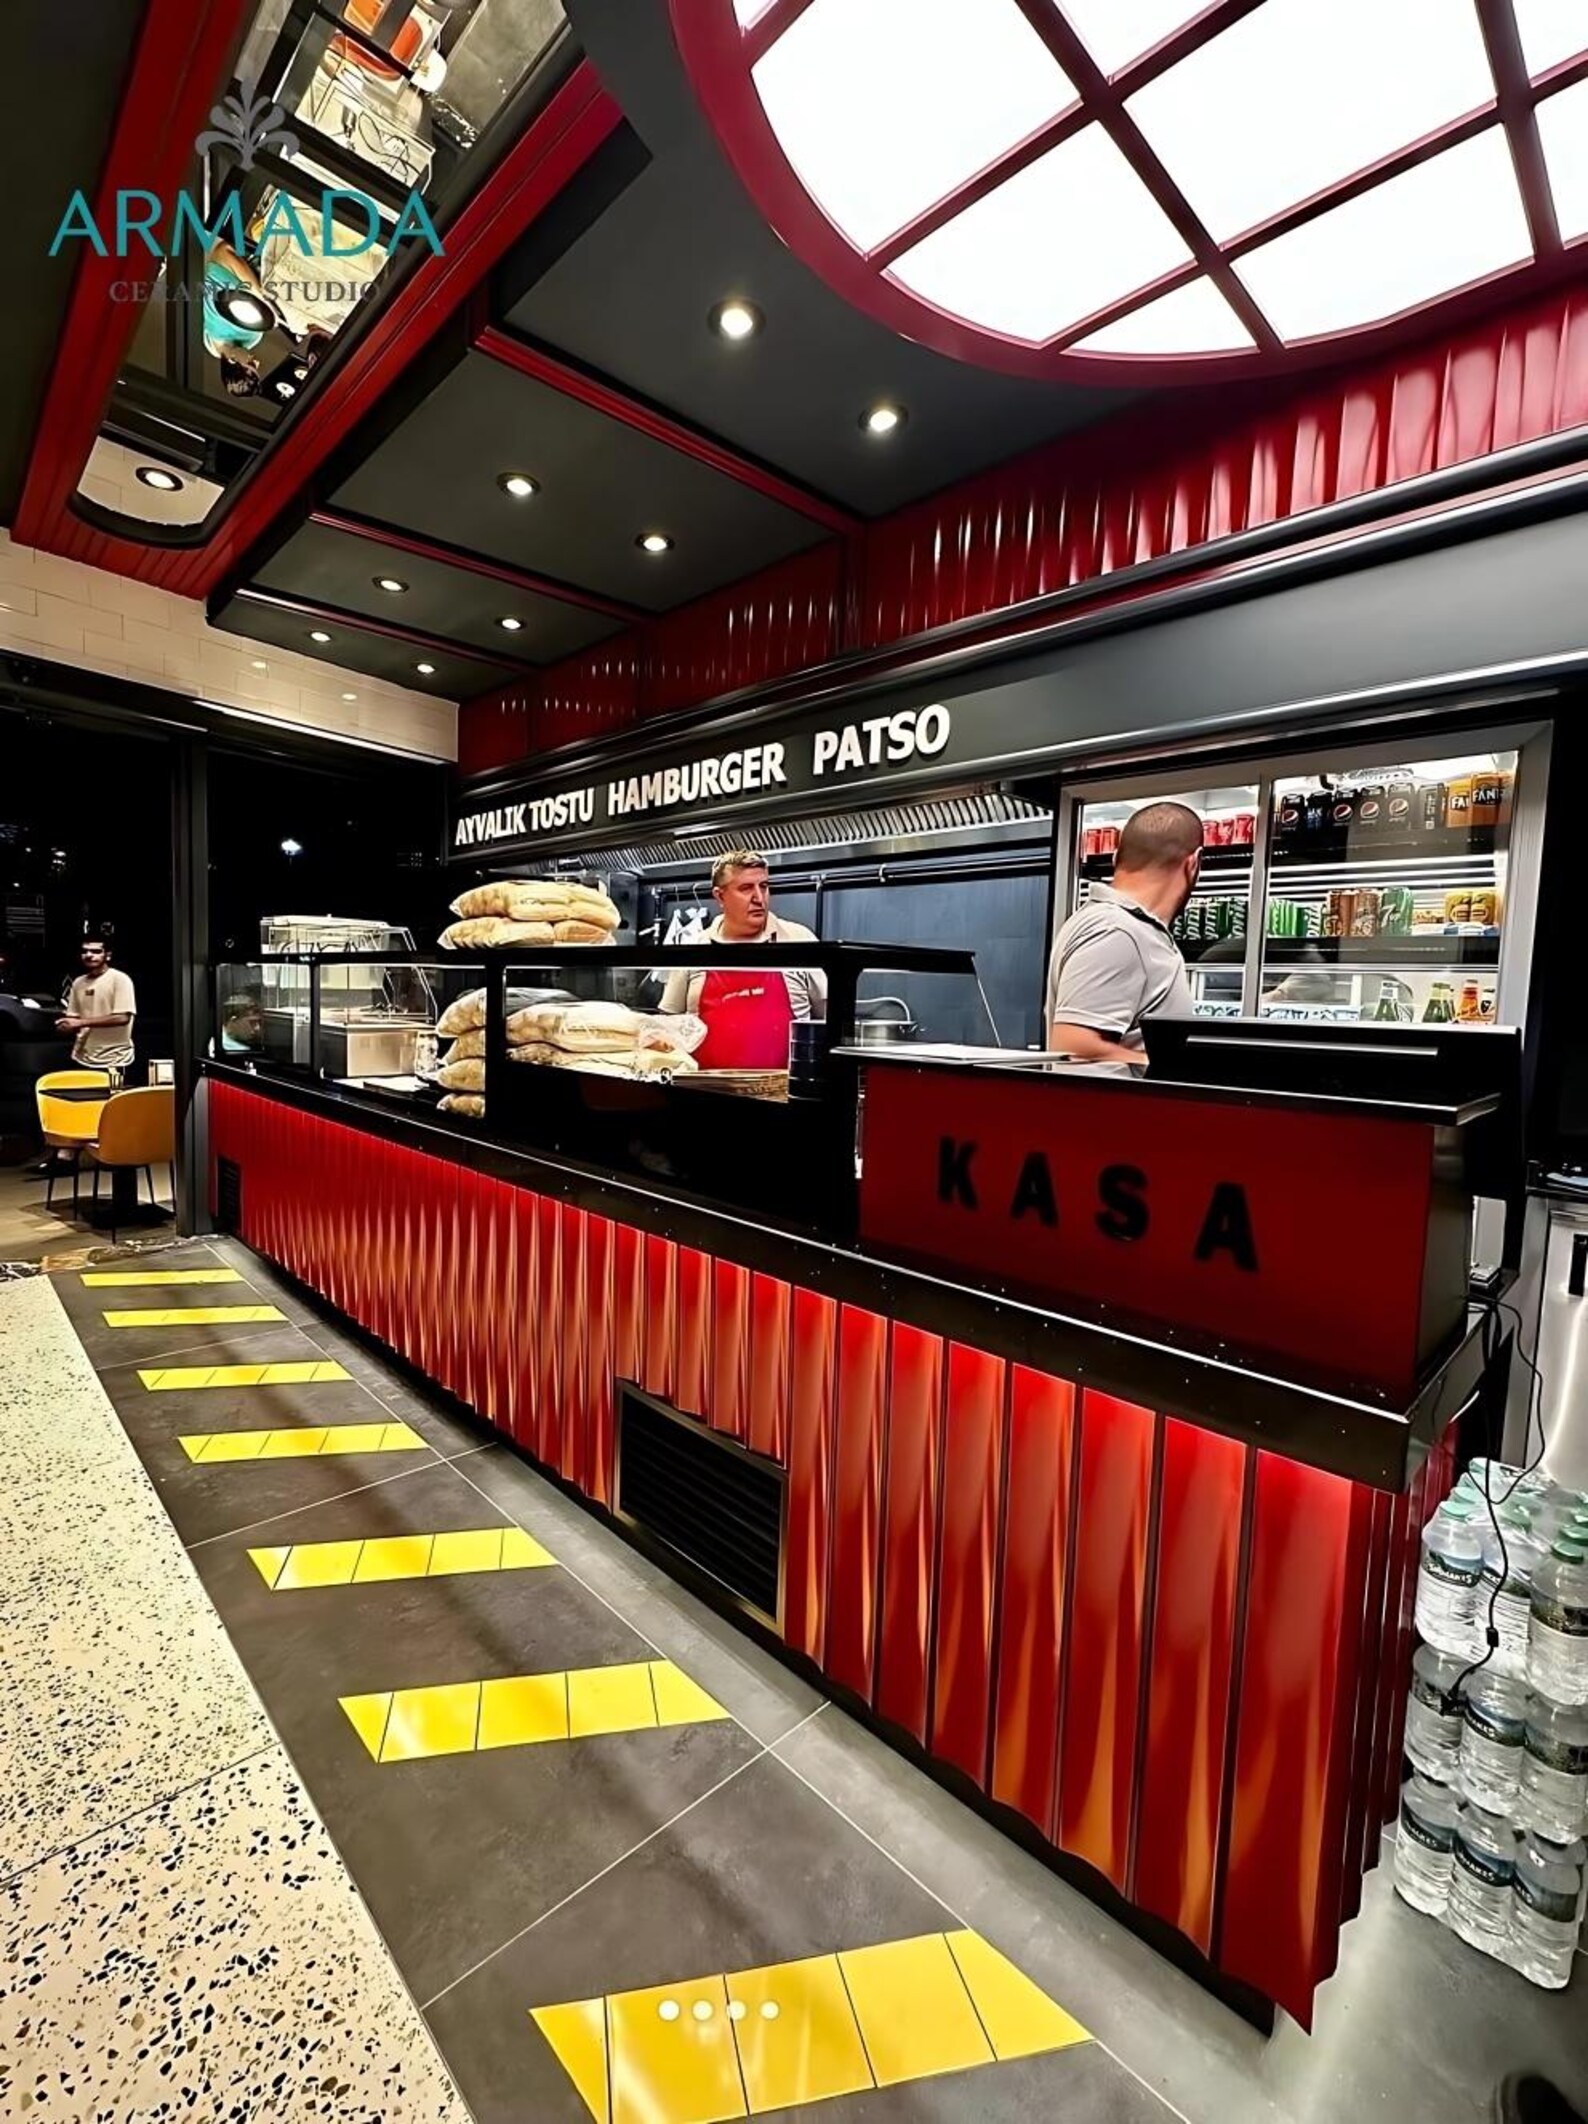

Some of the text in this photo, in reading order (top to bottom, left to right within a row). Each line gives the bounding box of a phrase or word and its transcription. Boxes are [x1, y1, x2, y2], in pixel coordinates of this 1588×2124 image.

[454, 704, 950, 846] AYVALIK TOSTU HAMBURGER PATSO
[938, 1135, 1259, 1273] KASA
